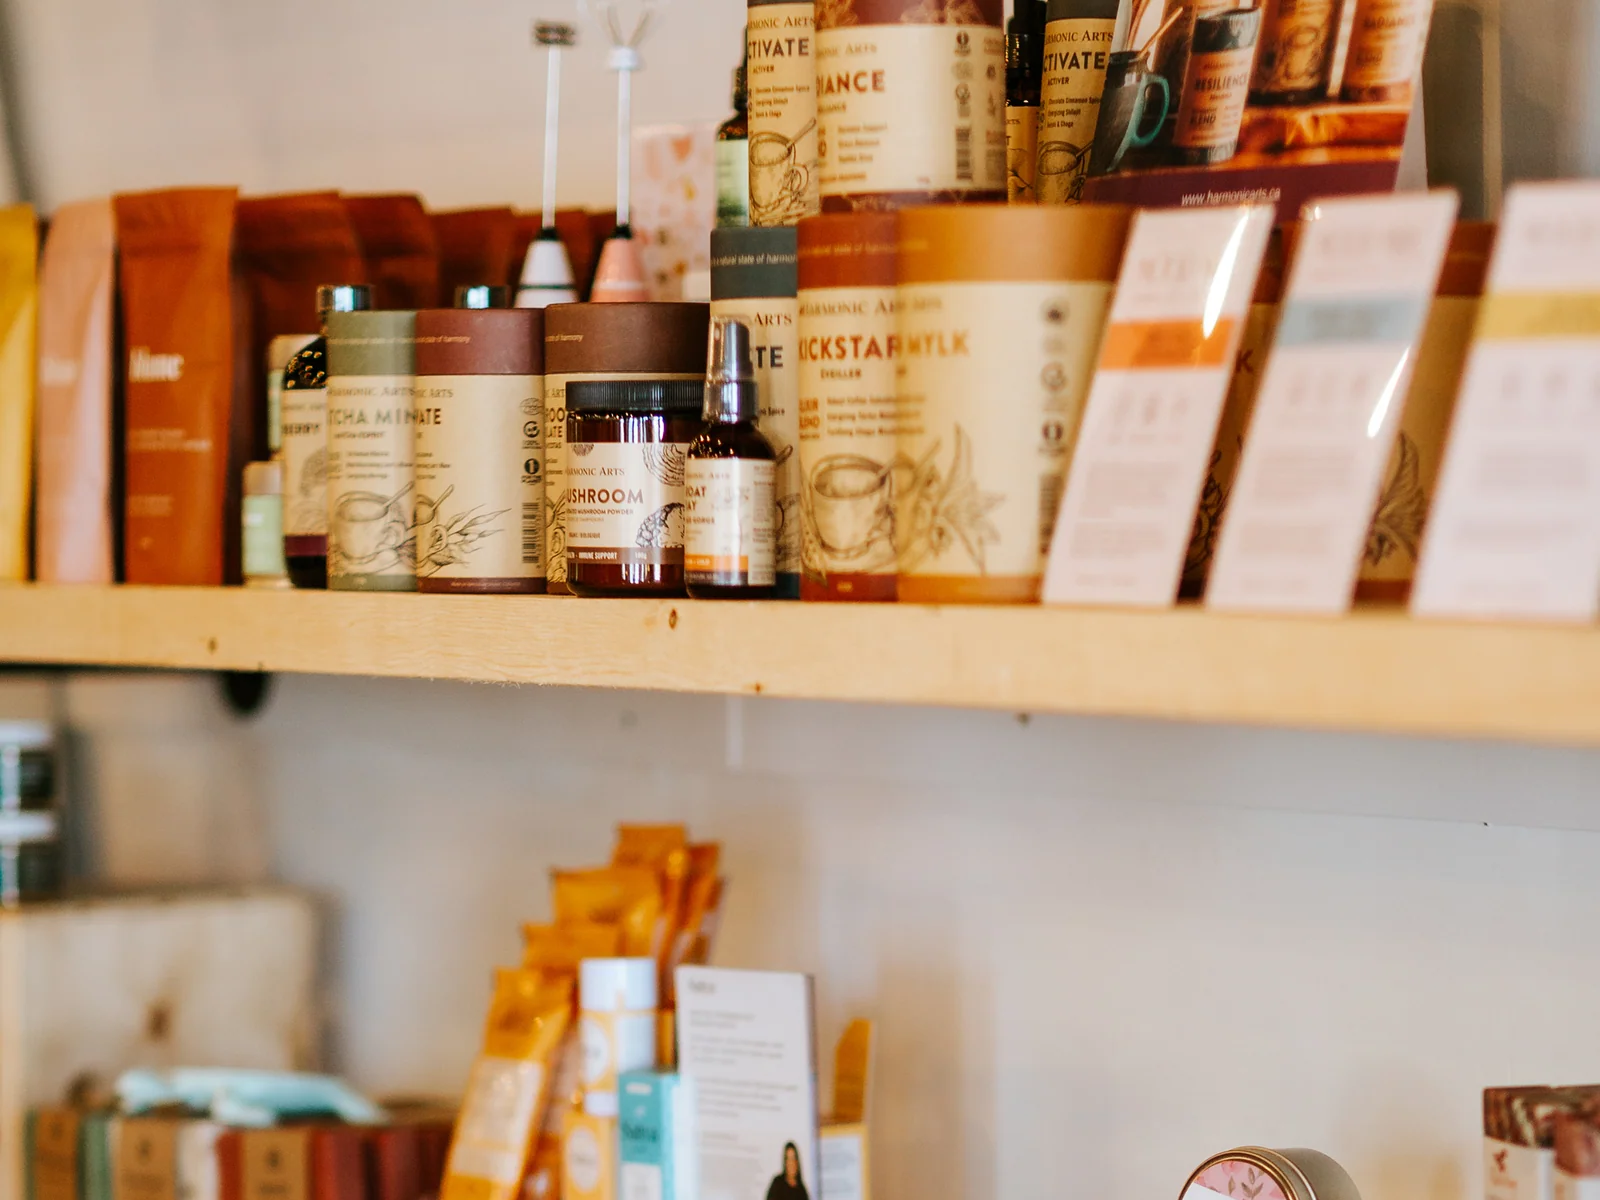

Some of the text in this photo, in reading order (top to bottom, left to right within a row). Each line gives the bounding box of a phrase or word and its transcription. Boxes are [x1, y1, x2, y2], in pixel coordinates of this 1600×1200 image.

[754, 312, 792, 326] ARTS
[798, 334, 898, 361] KICKSTAR
[755, 346, 784, 369] TE
[416, 408, 442, 425] ATE
[566, 467, 597, 477] ARMONIC
[594, 551, 618, 560] SUPPORT
